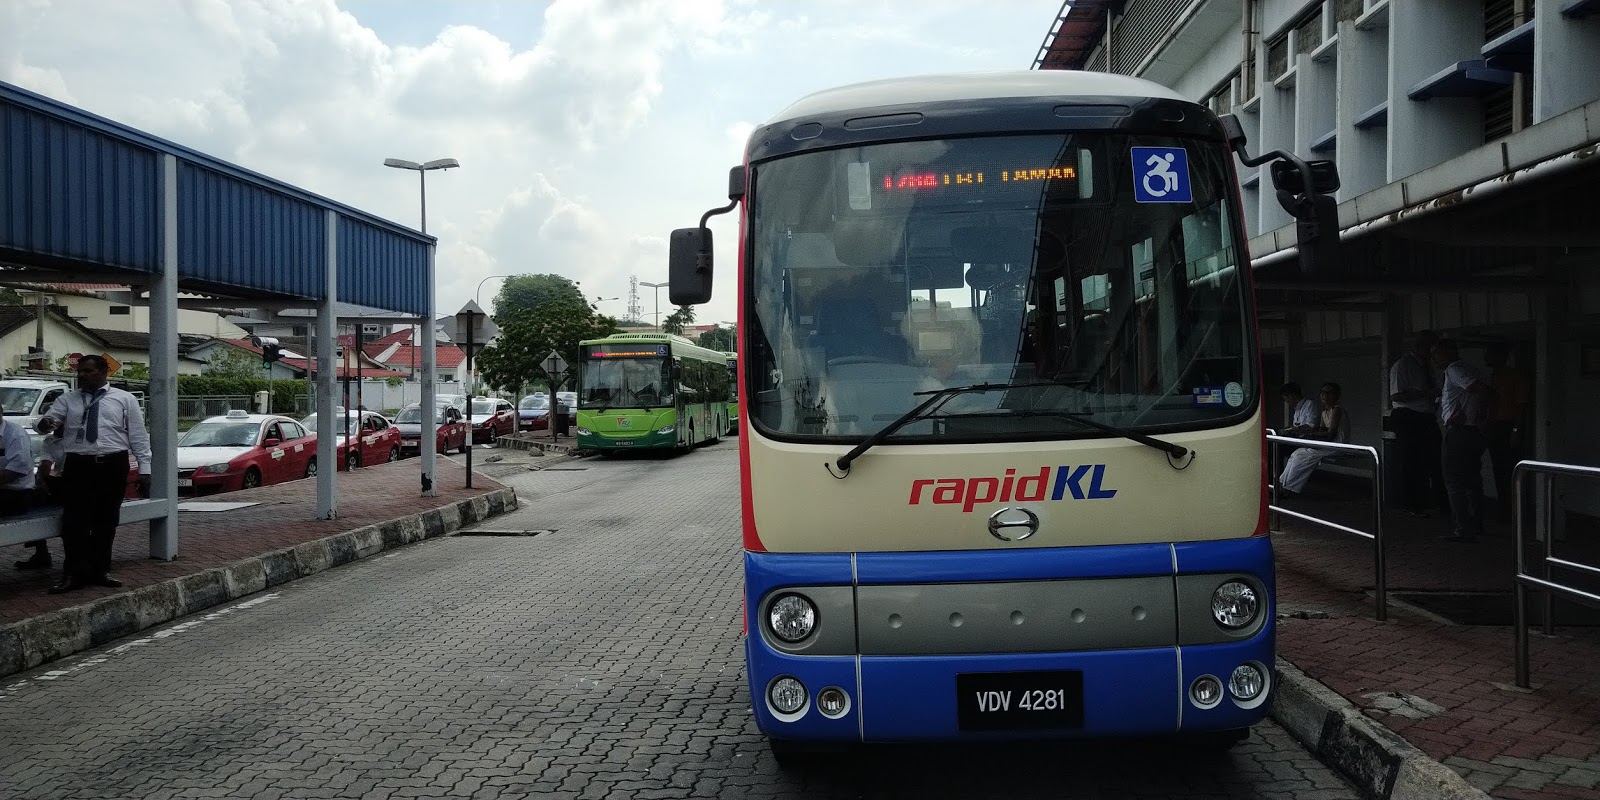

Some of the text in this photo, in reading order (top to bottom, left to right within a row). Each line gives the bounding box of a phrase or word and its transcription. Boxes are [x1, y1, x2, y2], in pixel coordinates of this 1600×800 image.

[908, 464, 1118, 513] rapidKL
[976, 689, 1065, 712] VDV 4281
